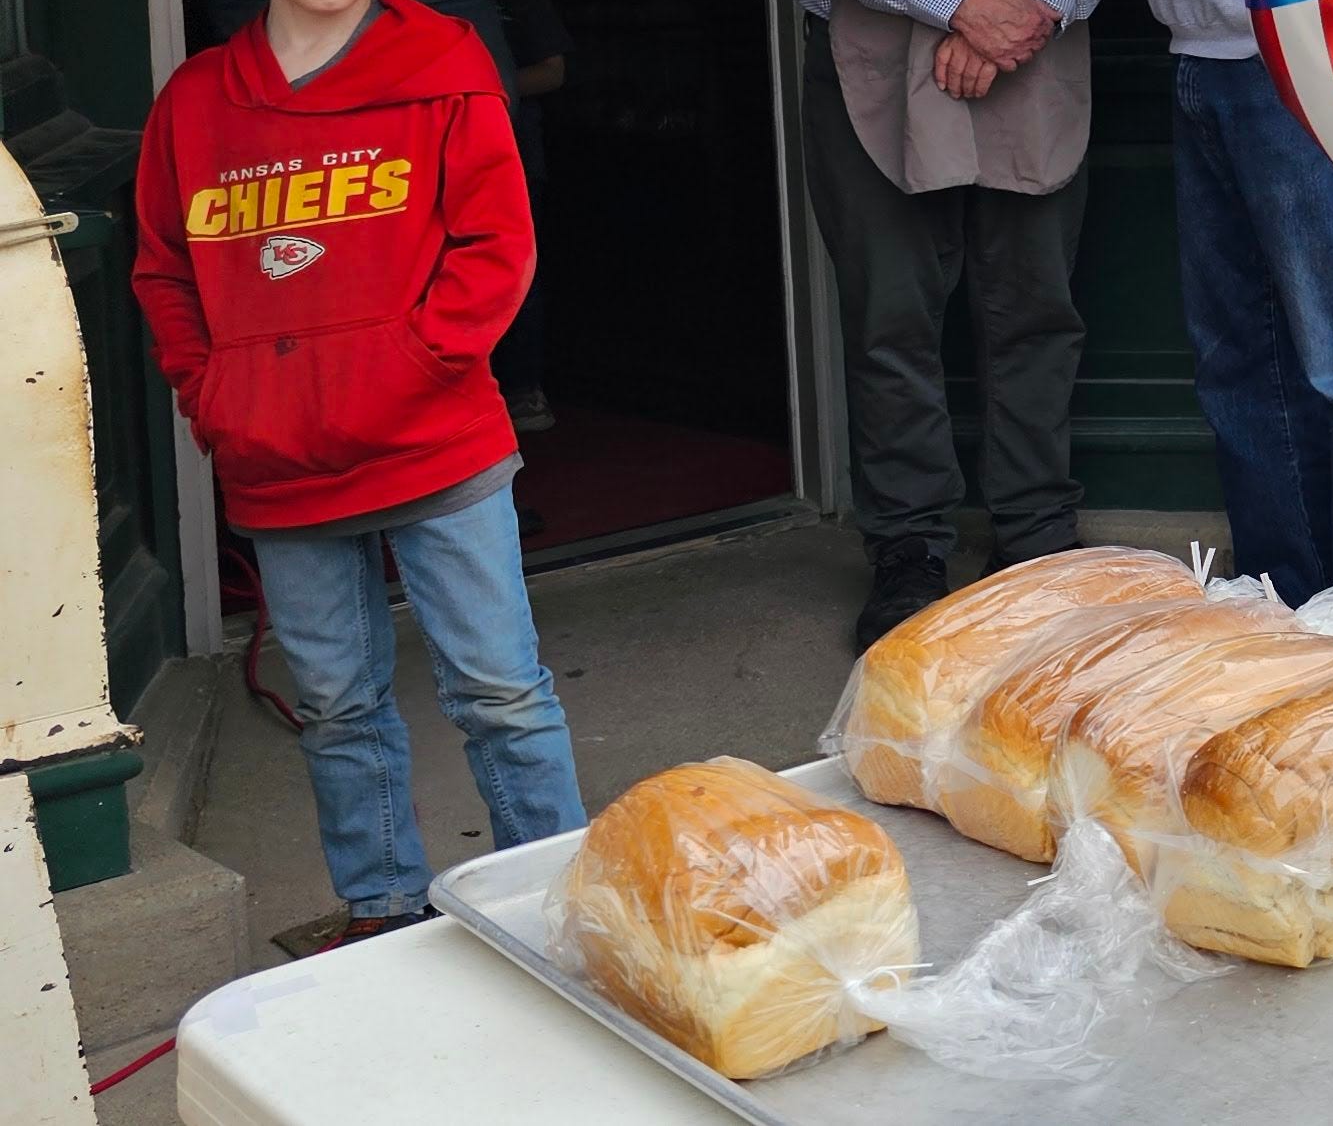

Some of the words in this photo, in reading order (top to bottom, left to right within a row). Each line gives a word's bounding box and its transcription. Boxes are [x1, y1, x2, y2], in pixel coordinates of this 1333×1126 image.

[219, 159, 304, 184] KANSAS
[322, 148, 383, 166] CITY
[186, 158, 413, 236] CHIEFS
